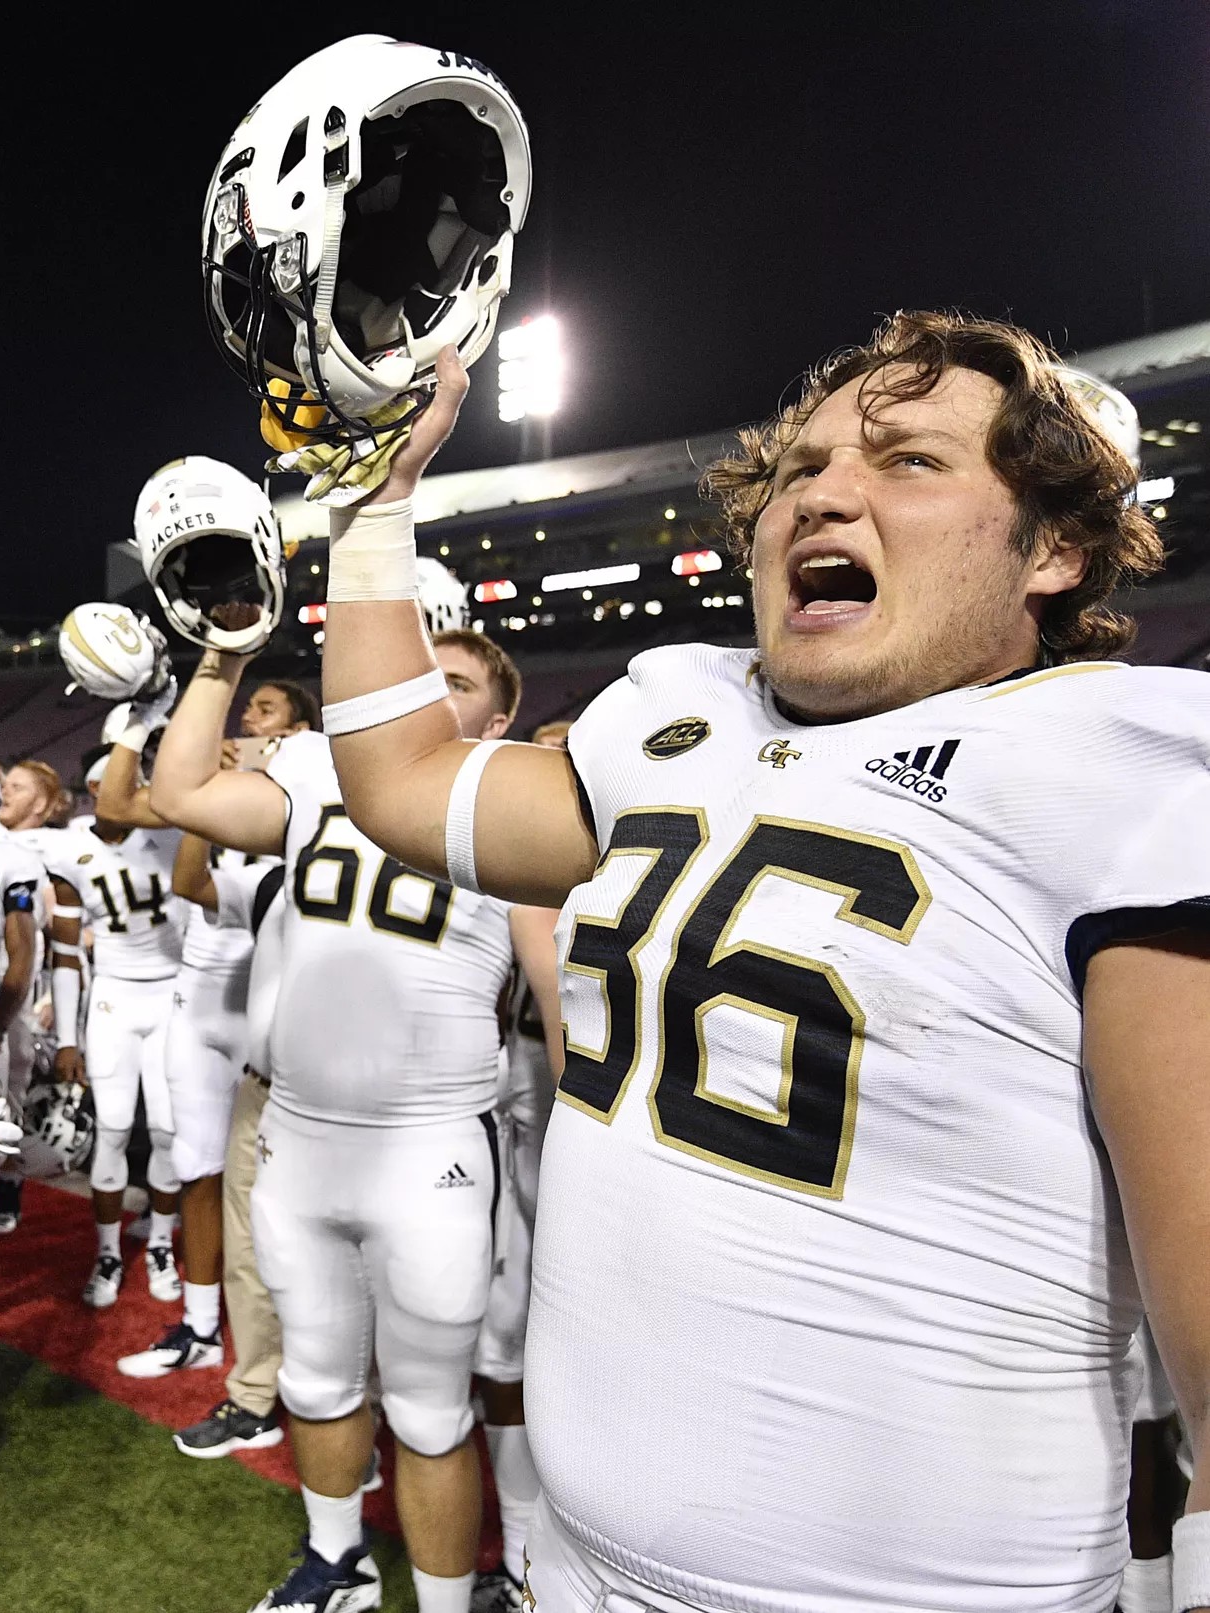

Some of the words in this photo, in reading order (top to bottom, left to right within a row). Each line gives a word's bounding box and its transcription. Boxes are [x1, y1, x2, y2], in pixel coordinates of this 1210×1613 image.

[151, 512, 216, 553] JACKETS
[757, 739, 802, 769] GT
[865, 757, 948, 803] adidas
[92, 867, 168, 933] 14
[555, 804, 933, 1201] 36
[434, 1178, 476, 1189] adidas
